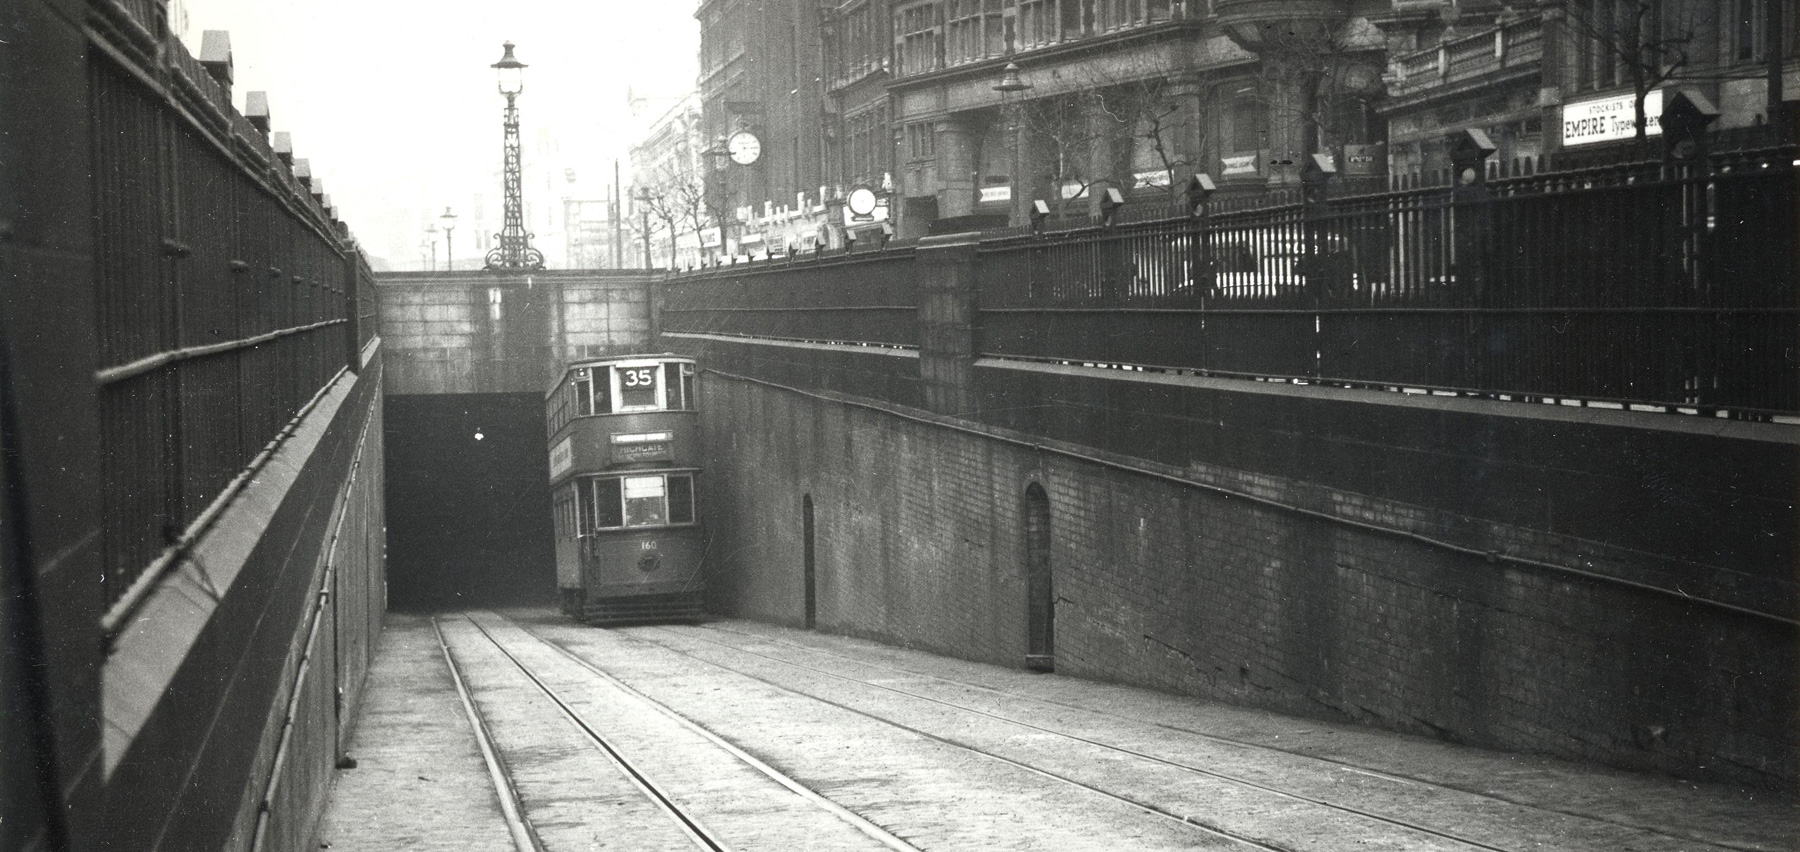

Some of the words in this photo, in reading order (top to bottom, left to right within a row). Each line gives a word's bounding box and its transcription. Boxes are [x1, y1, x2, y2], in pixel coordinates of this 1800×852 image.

[1589, 102, 1623, 114] STOCKISTS
[1565, 116, 1606, 138] EMPIRE
[625, 369, 652, 387] 35
[620, 444, 664, 454] HIGHGATE
[641, 540, 657, 550] 160
